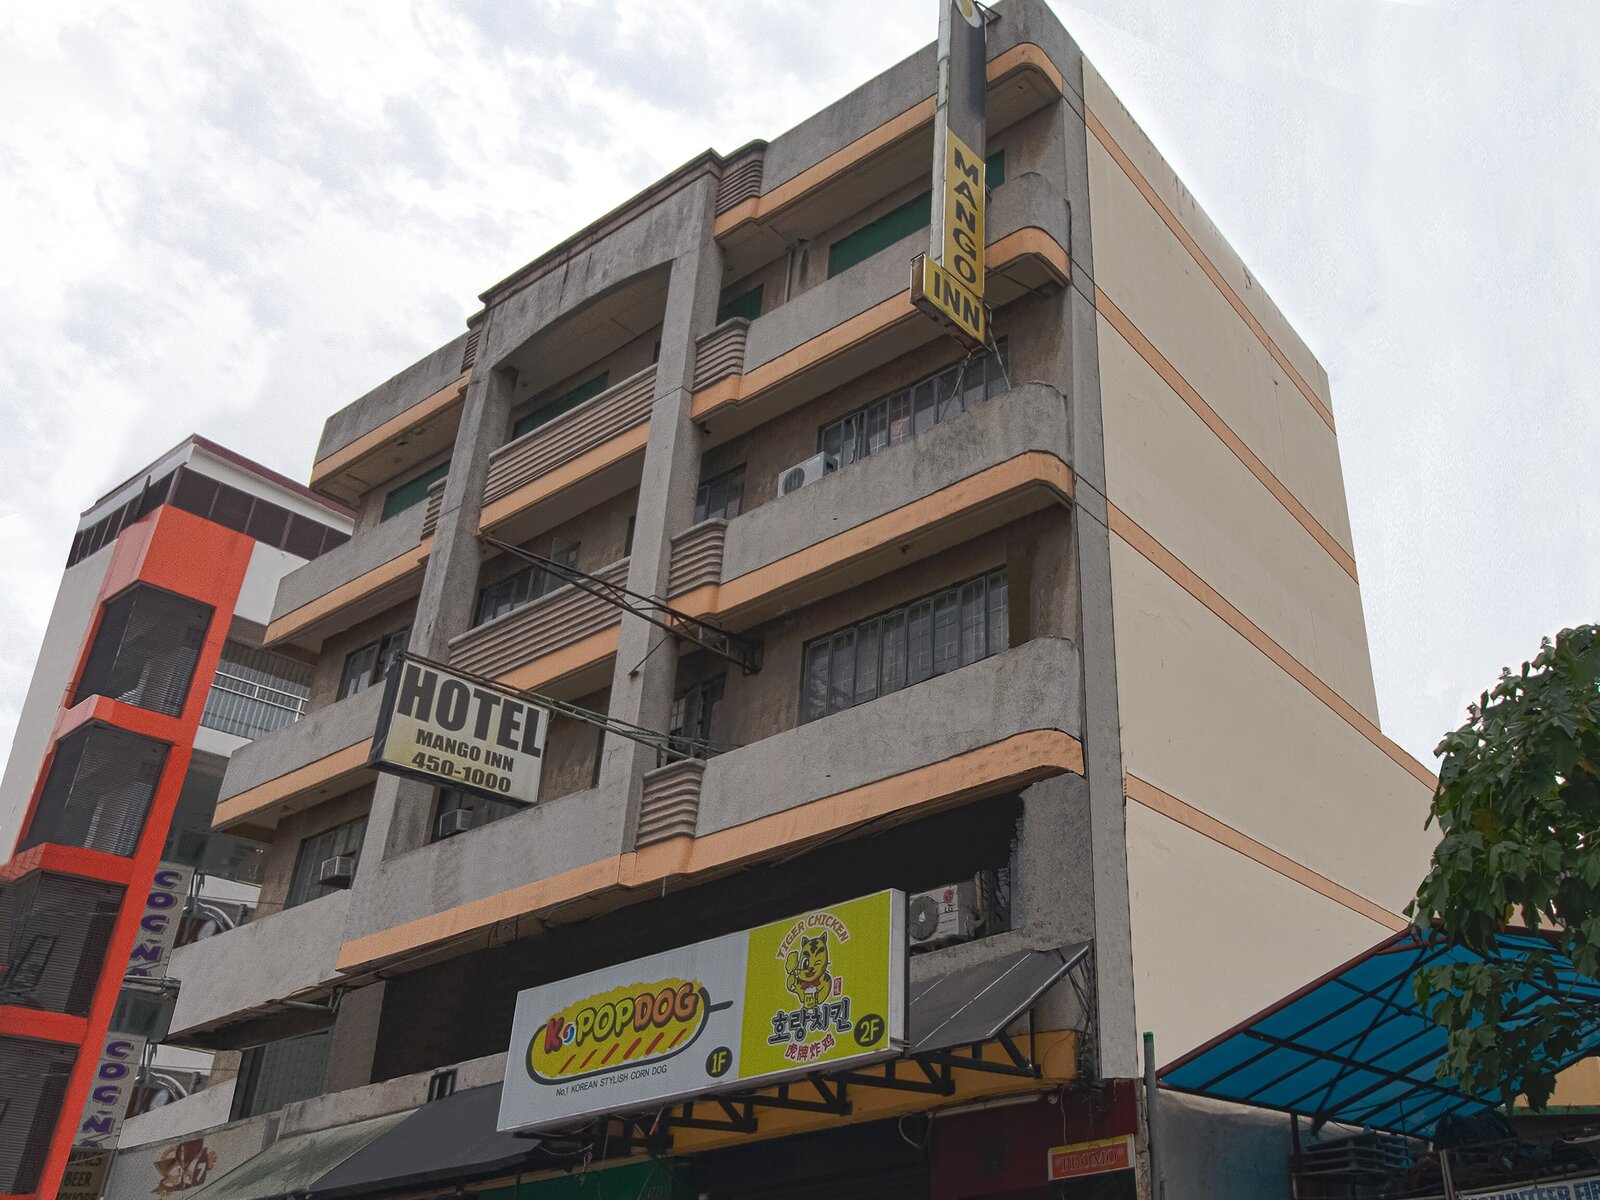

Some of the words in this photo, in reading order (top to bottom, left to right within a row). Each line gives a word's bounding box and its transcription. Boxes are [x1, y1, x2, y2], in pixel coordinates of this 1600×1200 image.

[953, 147, 979, 285] MANGO
[934, 271, 980, 332] INN
[397, 665, 541, 758] HOTEL
[415, 728, 480, 762] MANGO
[484, 749, 514, 772] INN
[411, 751, 512, 793] 450-1000
[776, 920, 806, 960] TIGER
[807, 914, 849, 943] CHICKEN
[768, 998, 852, 1044] 호랑치킨
[860, 1018, 880, 1043] 2F
[570, 1079, 599, 1094] KOREAN
[599, 1072, 629, 1088] STYLISH
[630, 1068, 650, 1081] CORN
[651, 1064, 668, 1076] DOG
[711, 1051, 727, 1074] 1F
[64, 1171, 93, 1187] BEER
[1061, 1148, 1119, 1172] PROMO
